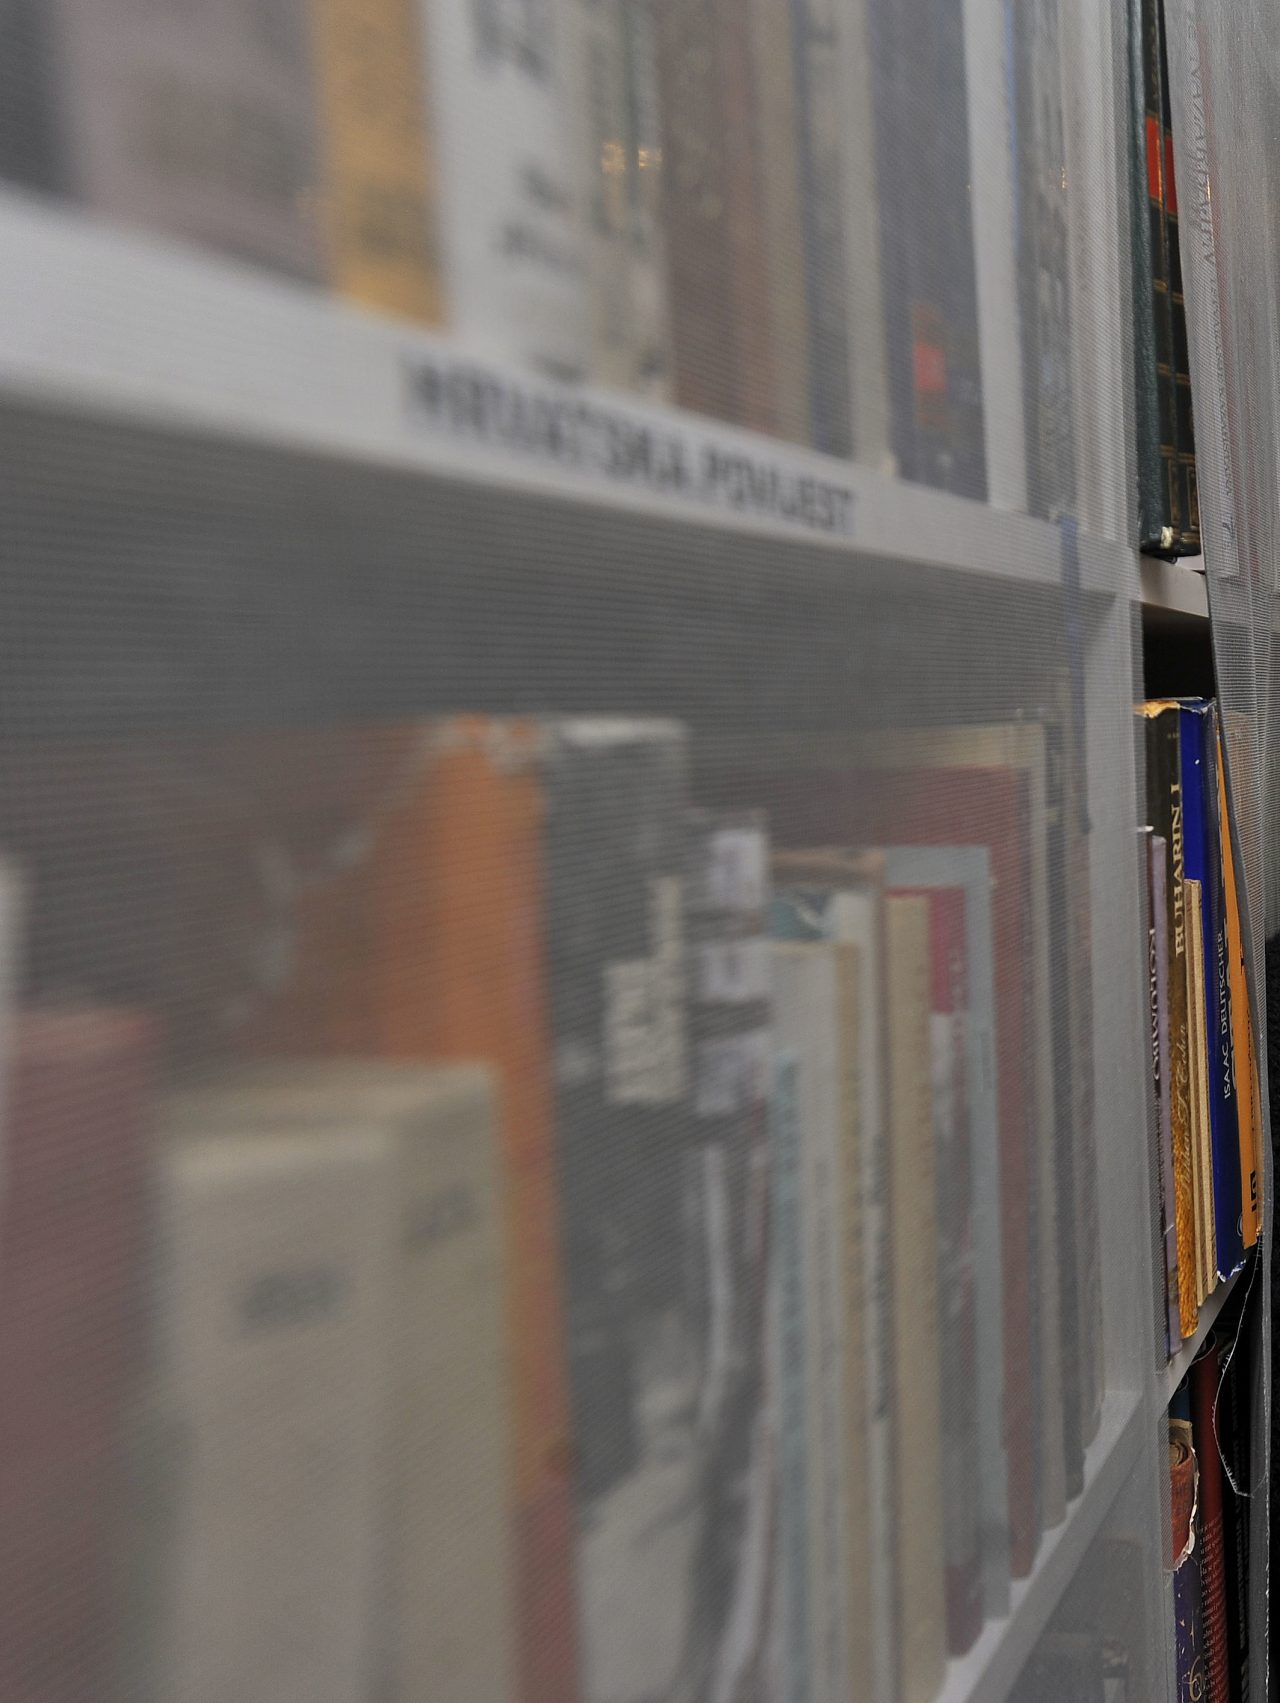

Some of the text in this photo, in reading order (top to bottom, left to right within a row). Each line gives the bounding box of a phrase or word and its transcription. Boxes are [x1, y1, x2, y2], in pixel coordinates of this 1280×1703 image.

[1171, 804, 1184, 957] BUHARIN
[1218, 932, 1230, 1098] ISAAC DEUTSCHER
